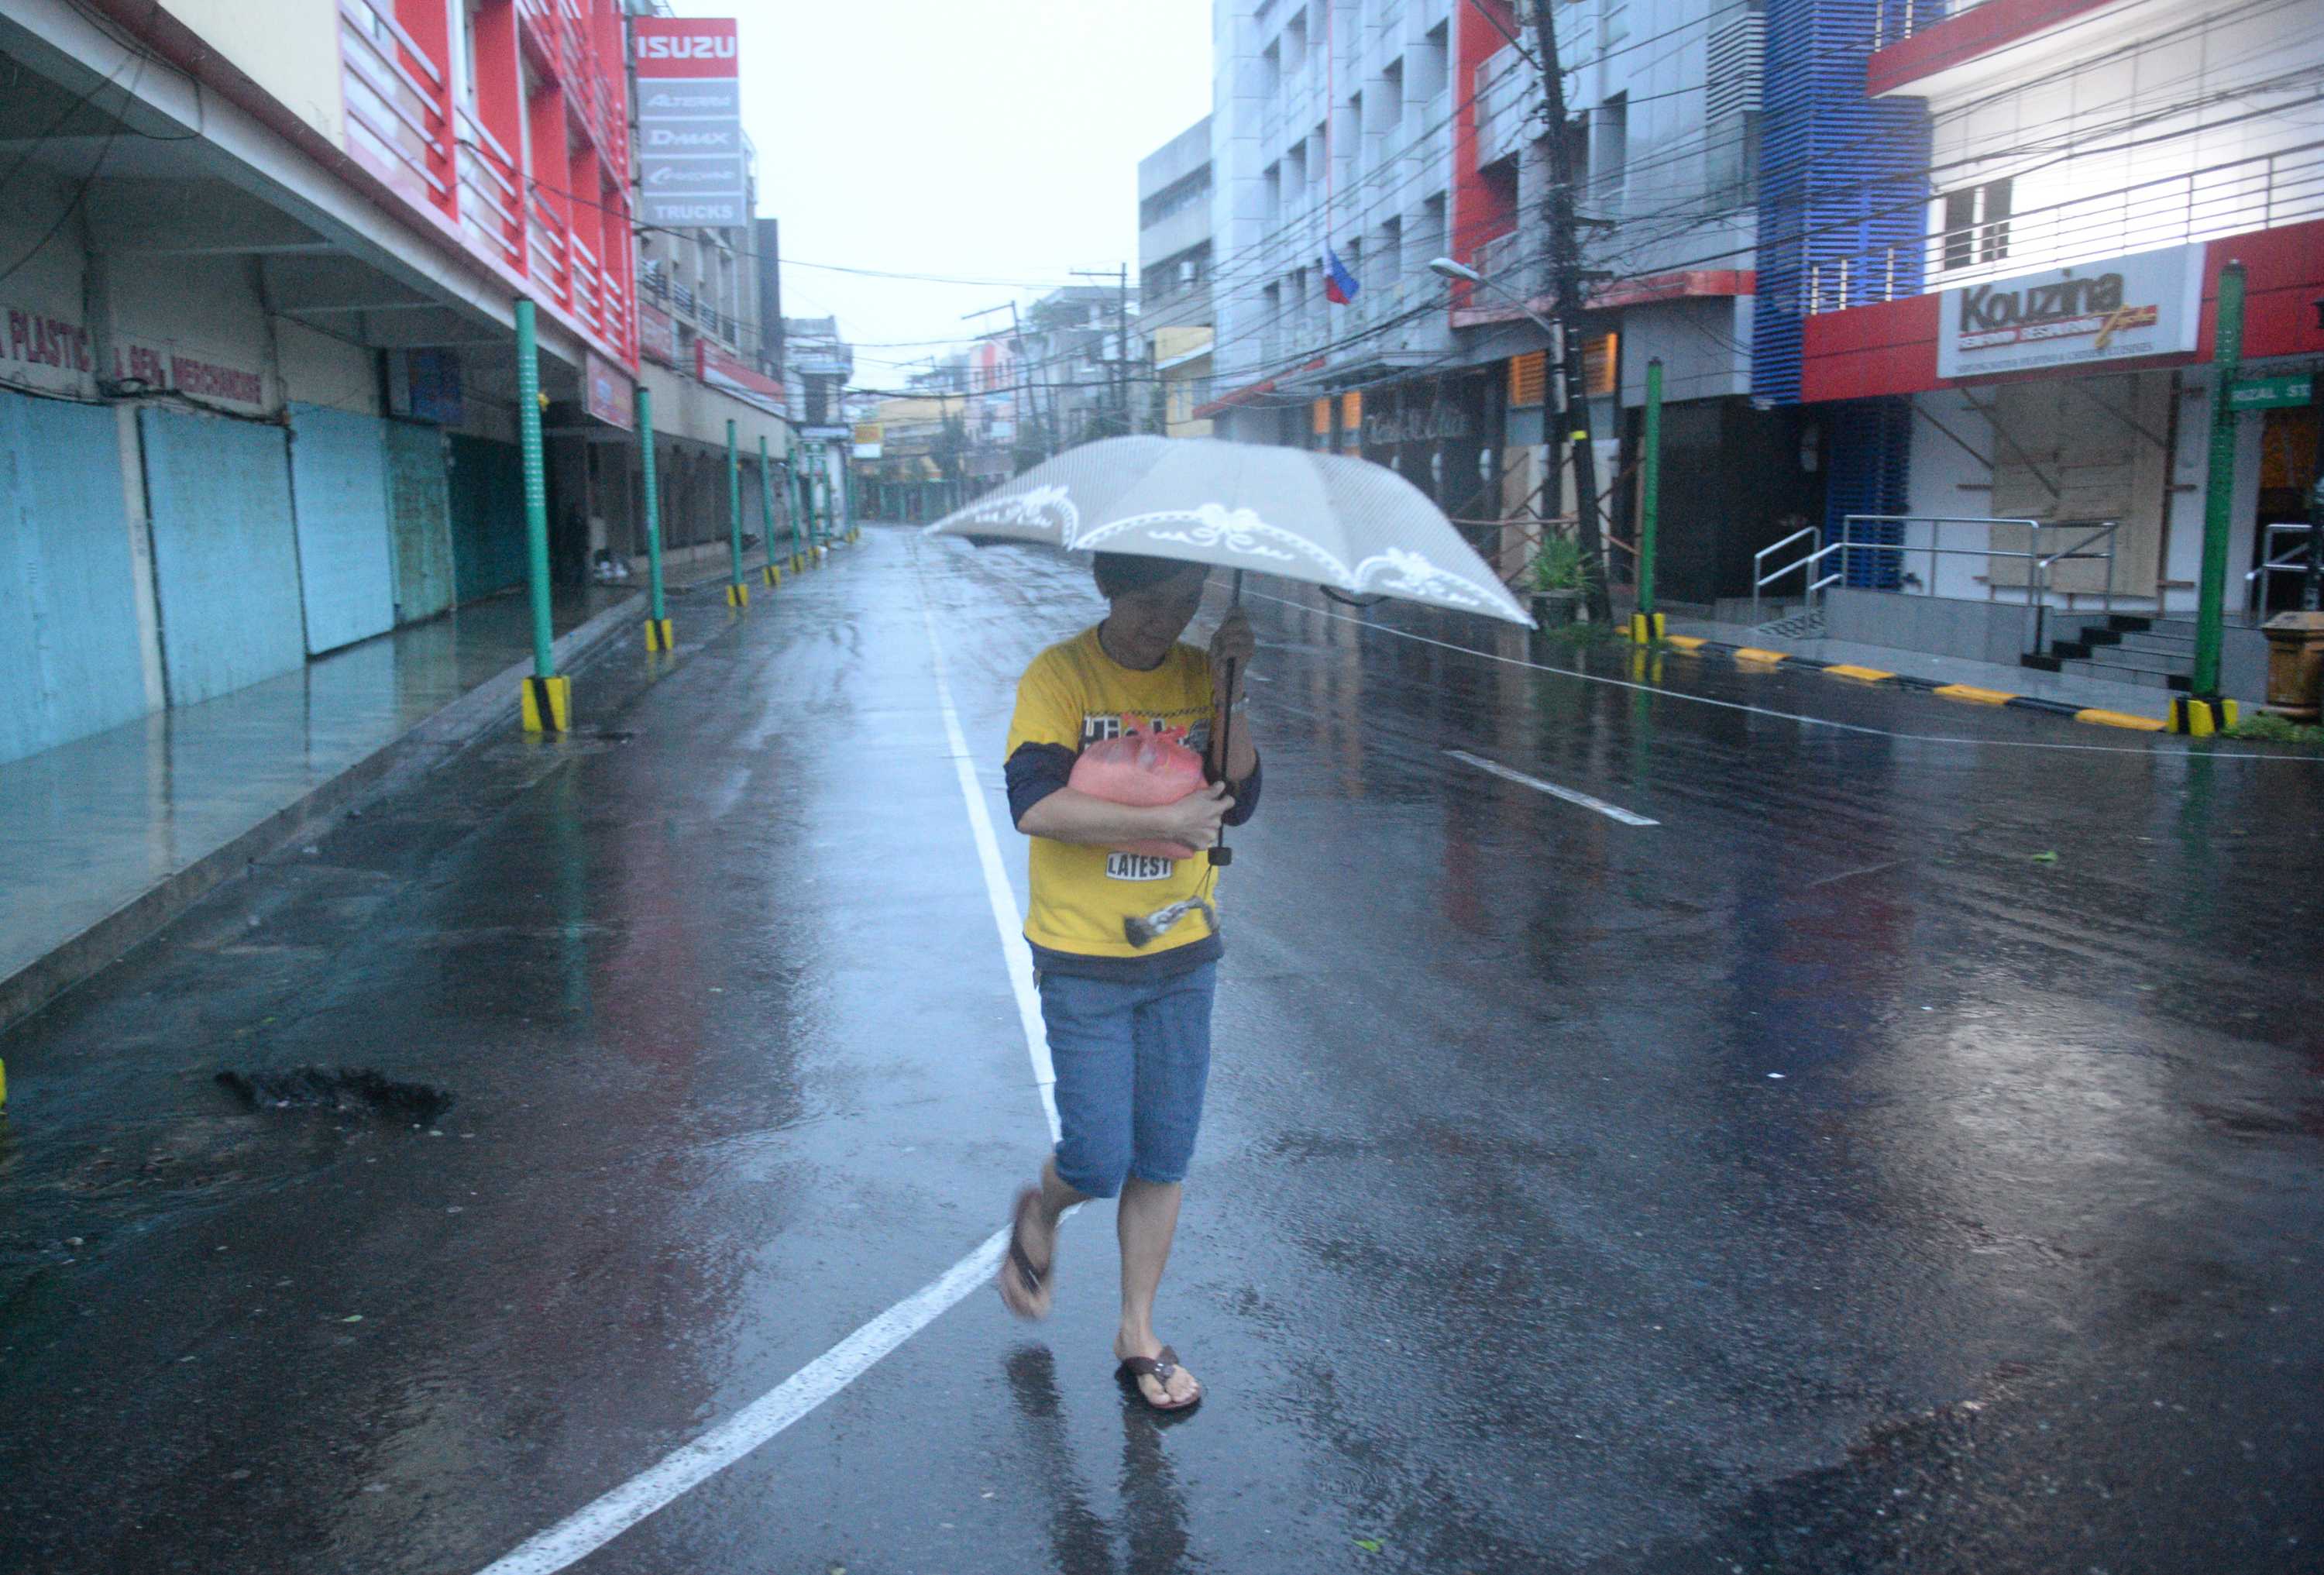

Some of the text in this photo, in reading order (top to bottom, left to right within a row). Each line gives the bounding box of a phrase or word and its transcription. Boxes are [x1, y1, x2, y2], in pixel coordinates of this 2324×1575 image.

[638, 36, 736, 59] ISUZU
[655, 205, 734, 219] TRUCKS
[1960, 268, 2123, 332] Kouzina
[1108, 852, 1168, 878] LATEST
